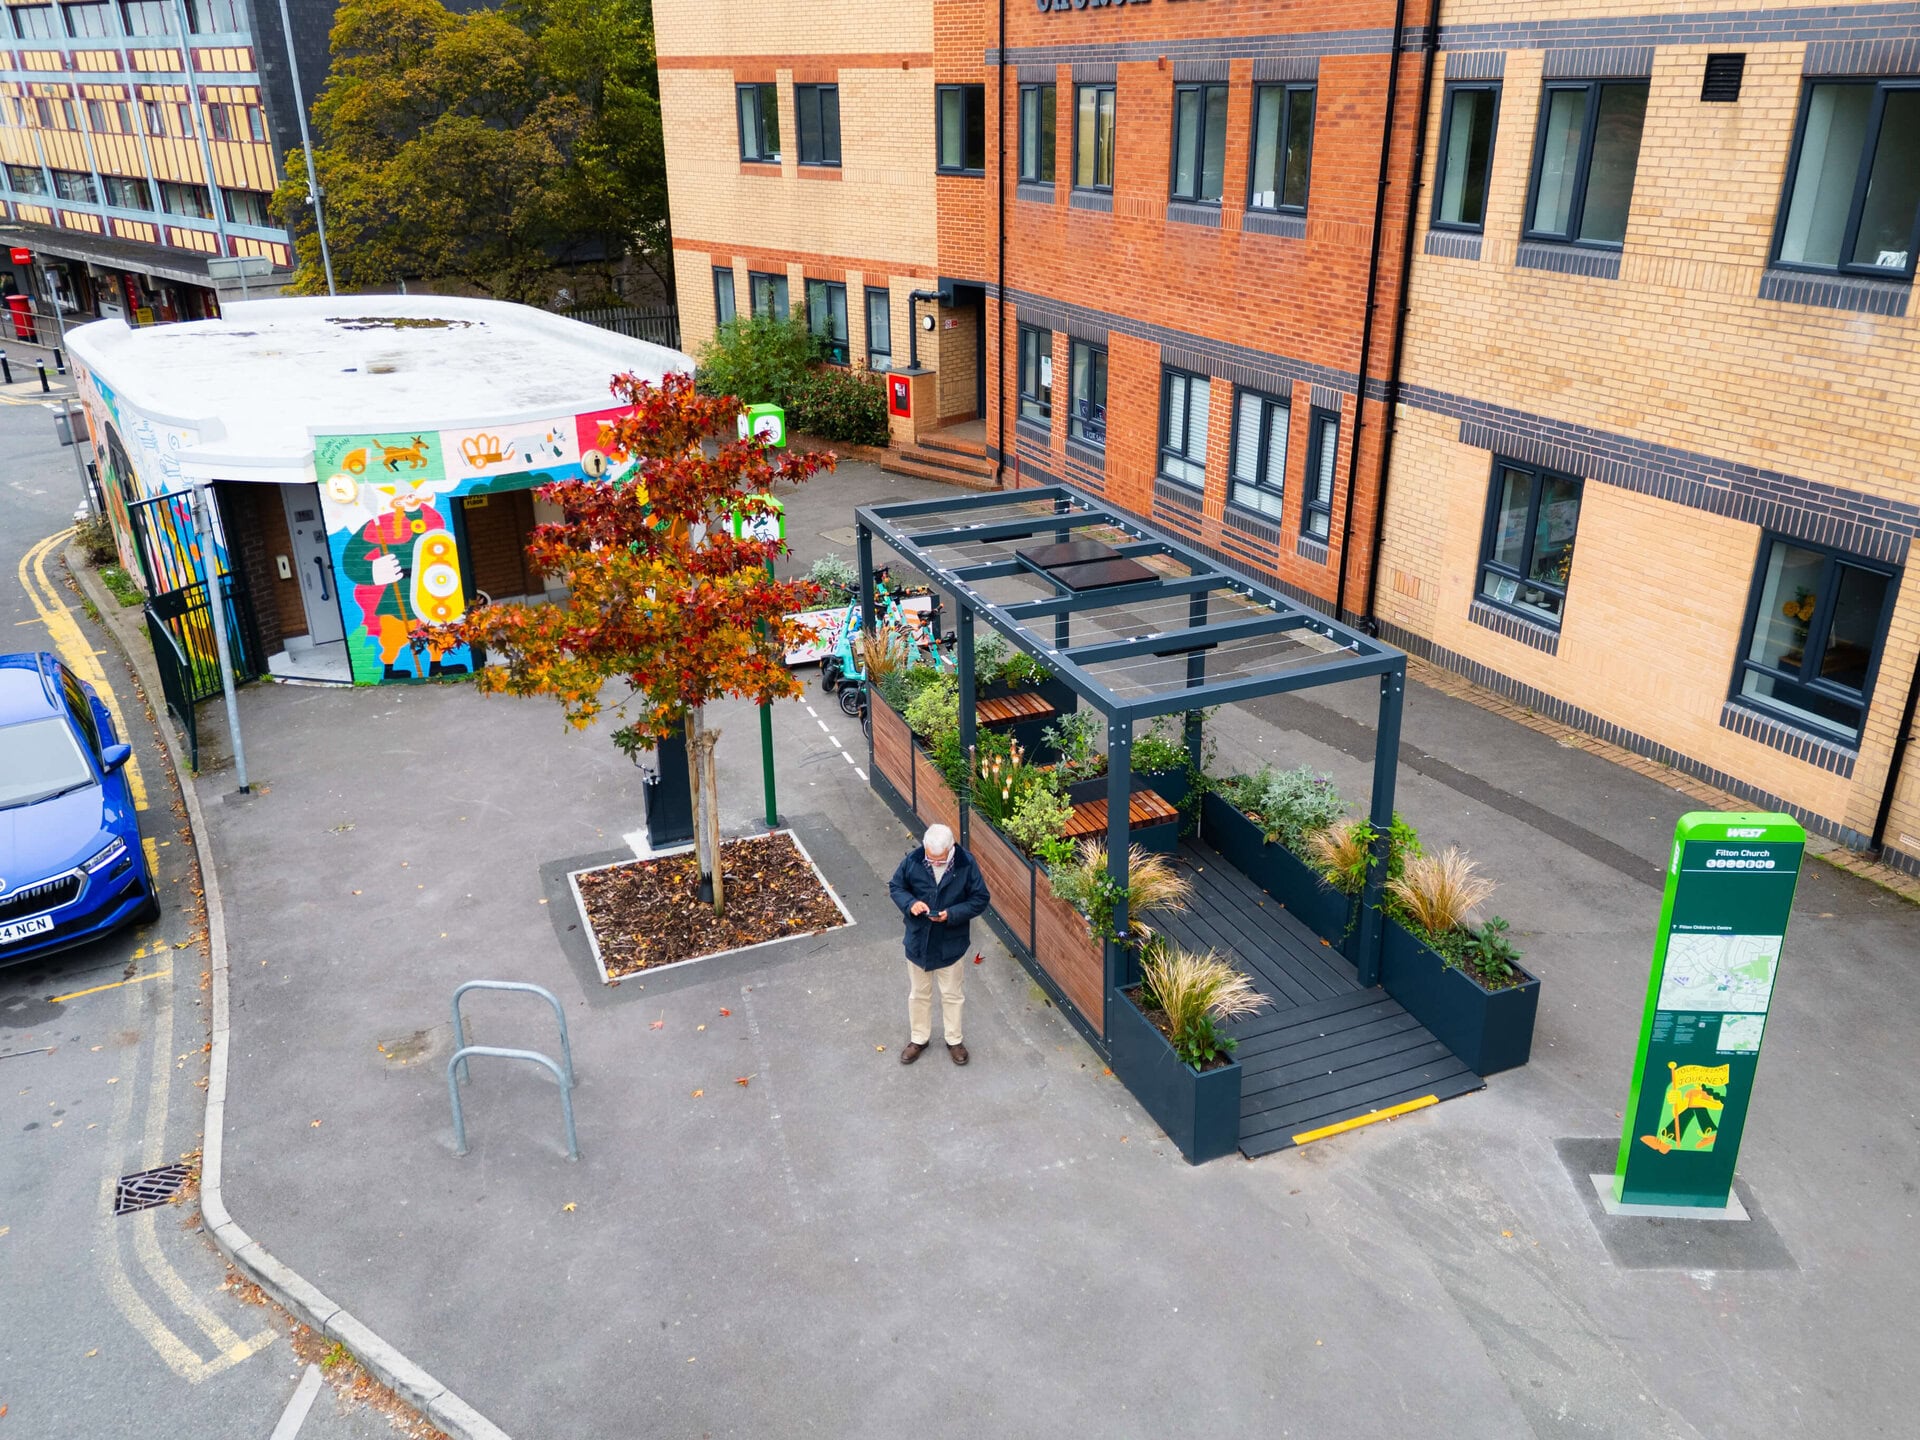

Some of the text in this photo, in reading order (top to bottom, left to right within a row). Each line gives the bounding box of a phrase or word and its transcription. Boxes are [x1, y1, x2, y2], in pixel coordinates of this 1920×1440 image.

[1086, 431, 1096, 439] FOR
[1726, 828, 1767, 838] WEST
[1715, 849, 1770, 857] Filton Church
[16, 918, 47, 936] NCN
[1679, 1076, 1727, 1086] JOURNEY
